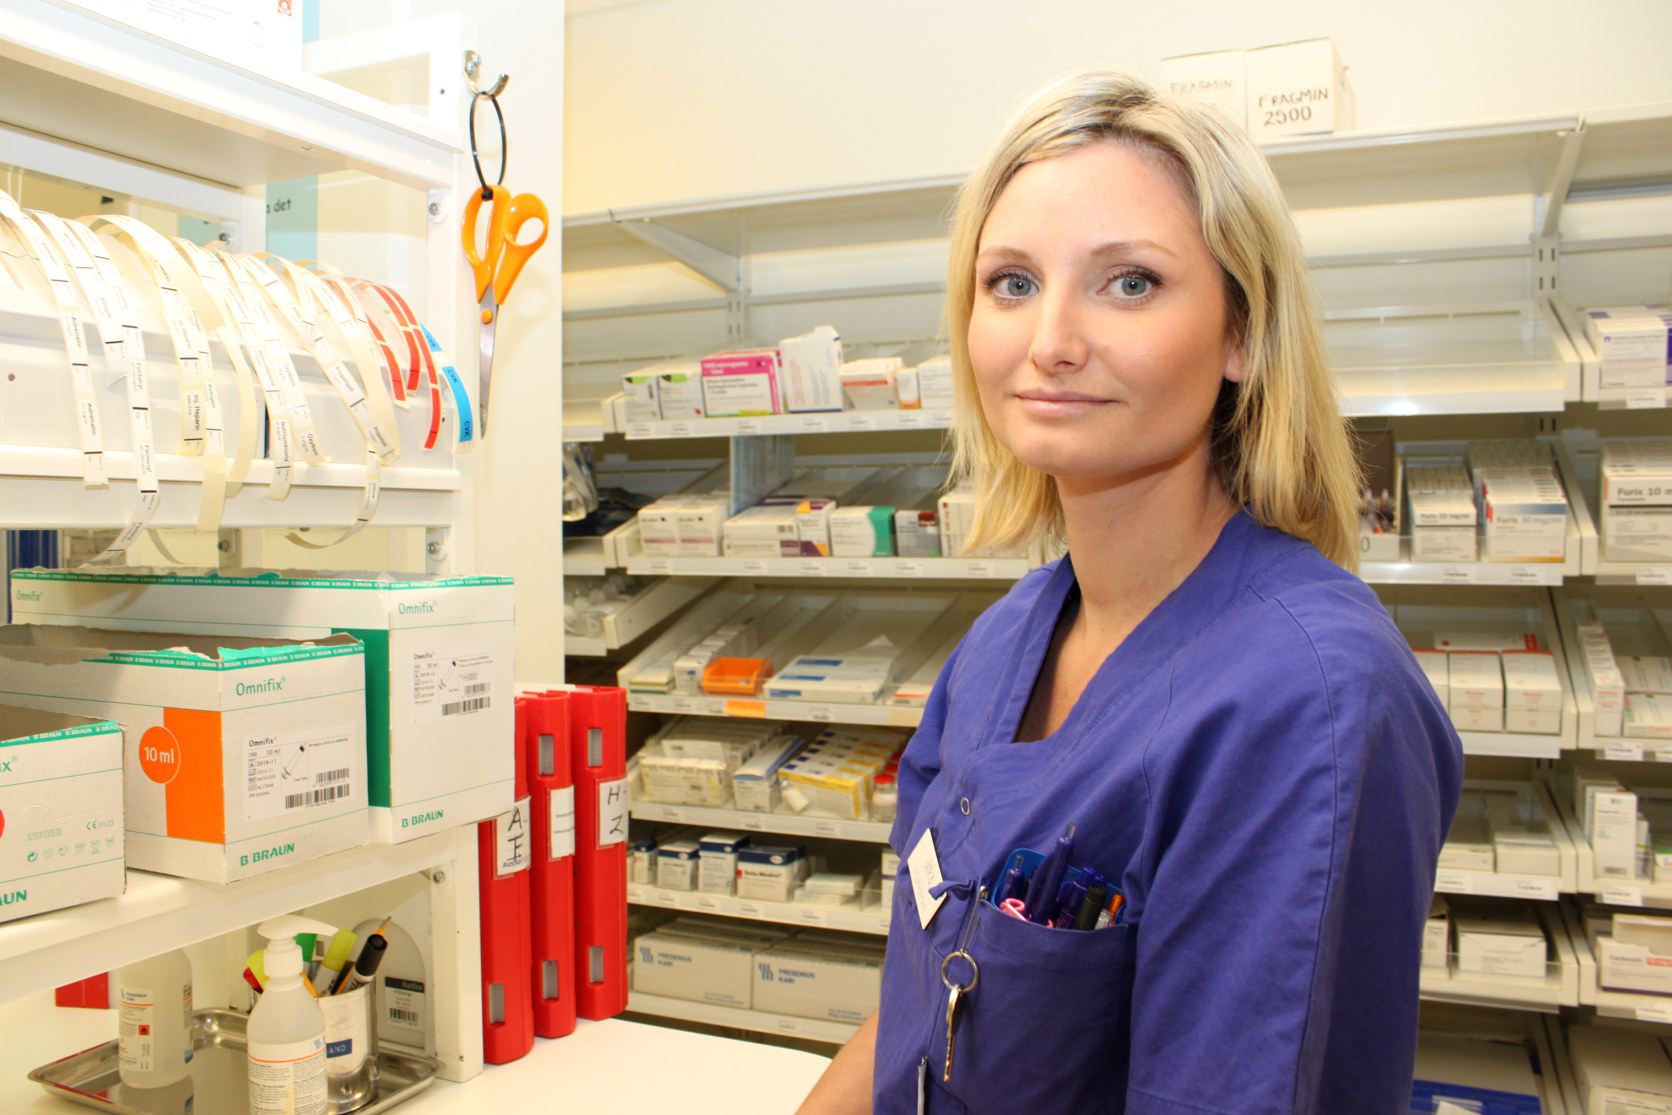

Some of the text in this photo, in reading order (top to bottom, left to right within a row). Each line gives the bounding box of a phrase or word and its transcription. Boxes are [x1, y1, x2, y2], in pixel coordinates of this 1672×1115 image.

[1170, 79, 1233, 94] FRAGMIN
[1259, 87, 1329, 108] FRAGMIN
[1263, 106, 1312, 127] 2500
[273, 198, 291, 212] det
[72, 316, 82, 348] Adrenalin
[425, 335, 436, 348] CVK
[448, 369, 459, 384] CVK
[88, 402, 96, 436] Adrenalin
[463, 420, 471, 438] CVK
[1618, 486, 1662, 496] Furix 10
[1497, 516, 1562, 526] Furix 10 mg/ml
[144, 746, 174, 764] 10 ml
[608, 785, 620, 805] H
[401, 809, 444, 828] B BRAUN
[508, 807, 522, 832] A
[610, 815, 624, 835] Z
[240, 842, 296, 867] B BRAUN
[658, 952, 692, 964] FRESENIUS
[658, 960, 674, 968] KABI
[778, 968, 816, 980] FRESENIUS
[778, 976, 796, 984] KABI
